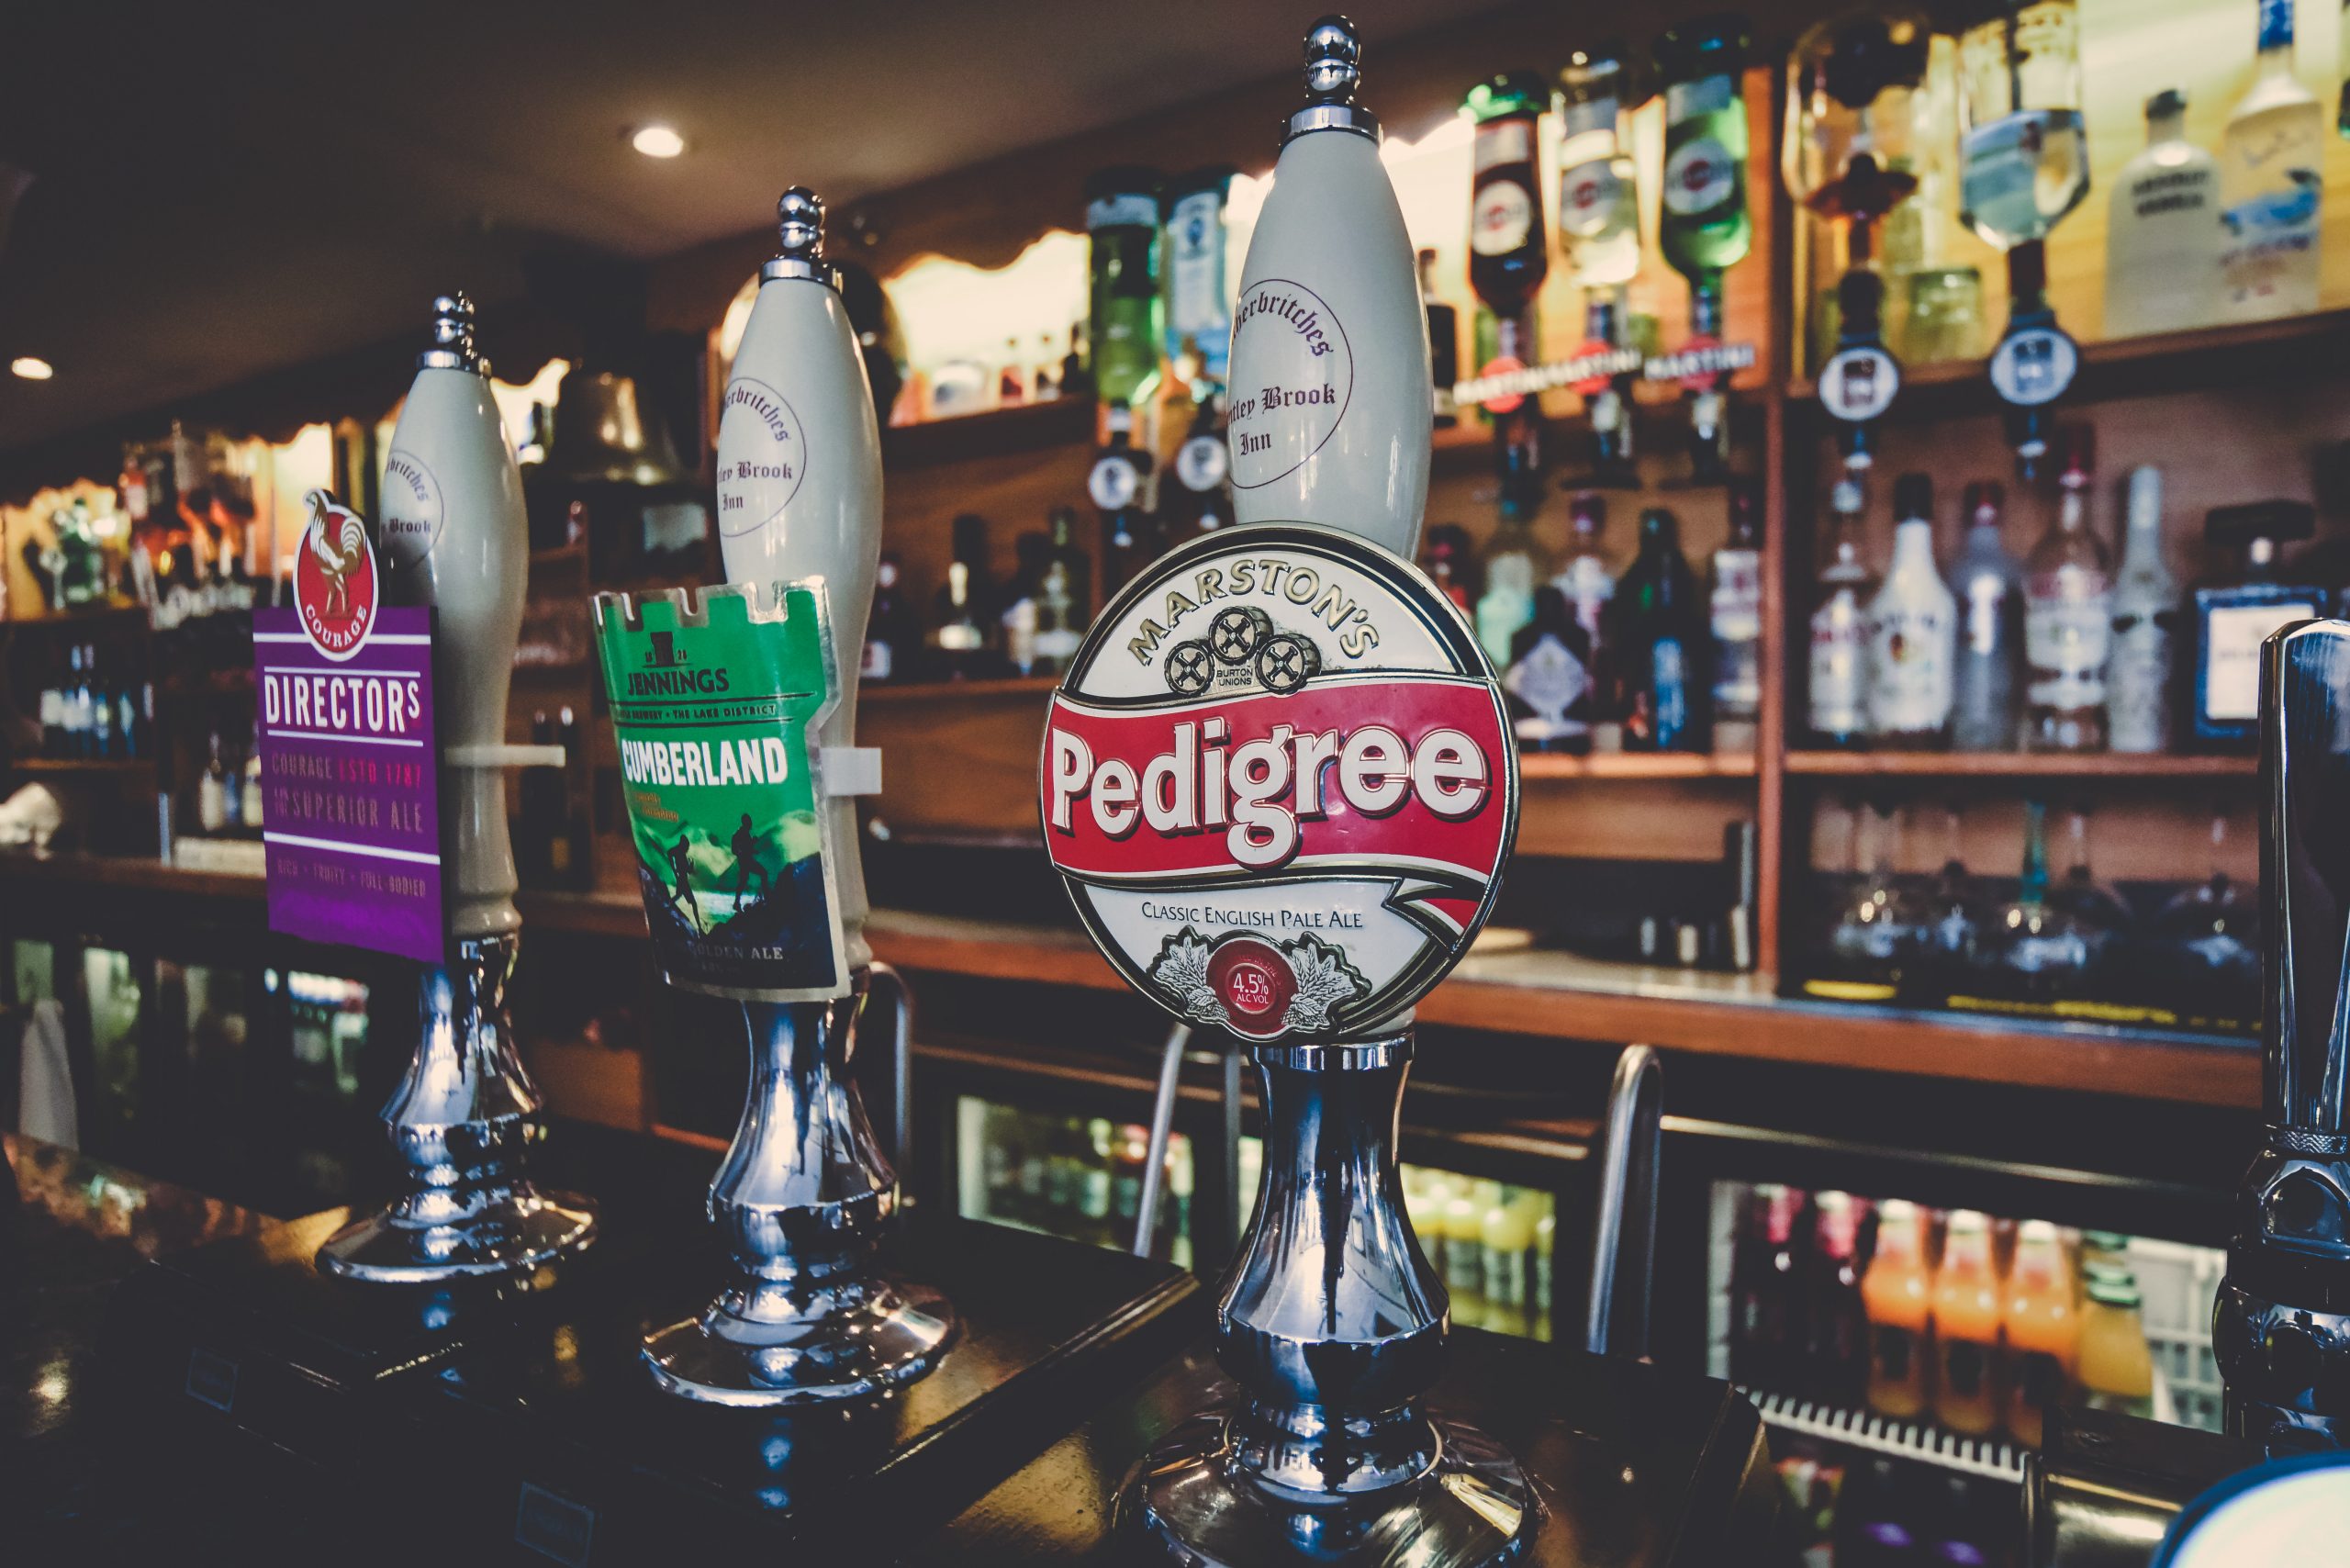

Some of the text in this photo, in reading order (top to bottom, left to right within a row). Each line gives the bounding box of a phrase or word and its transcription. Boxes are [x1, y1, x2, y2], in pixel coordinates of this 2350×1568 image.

[1262, 384, 1337, 415] Brook
[1240, 432, 1271, 456] Inn
[737, 461, 792, 480] Brook
[723, 493, 744, 511] Inn
[389, 518, 431, 533] Brook
[1127, 559, 1380, 666] MARSTON'S
[306, 604, 367, 648] COURAGE
[627, 668, 730, 697] JENNINGS
[1216, 666, 1253, 678] BURTON
[1218, 677, 1252, 687] UNIONS
[263, 675, 420, 733] DIRECTORS
[693, 708, 719, 719] LAKE
[723, 704, 777, 717] DISTRICT
[272, 753, 332, 779] COURAGE
[621, 737, 789, 787] CUMBERLAND
[1051, 716, 1492, 871] Pedigree
[293, 790, 379, 827] SUPERIOR
[391, 800, 424, 834] ALE
[1142, 902, 1363, 928] CLASSIC ENGLISH PALE ALE
[751, 946, 784, 960] ALE
[1233, 972, 1269, 994] 4.5%
[1237, 993, 1270, 1004] ALC VOL
